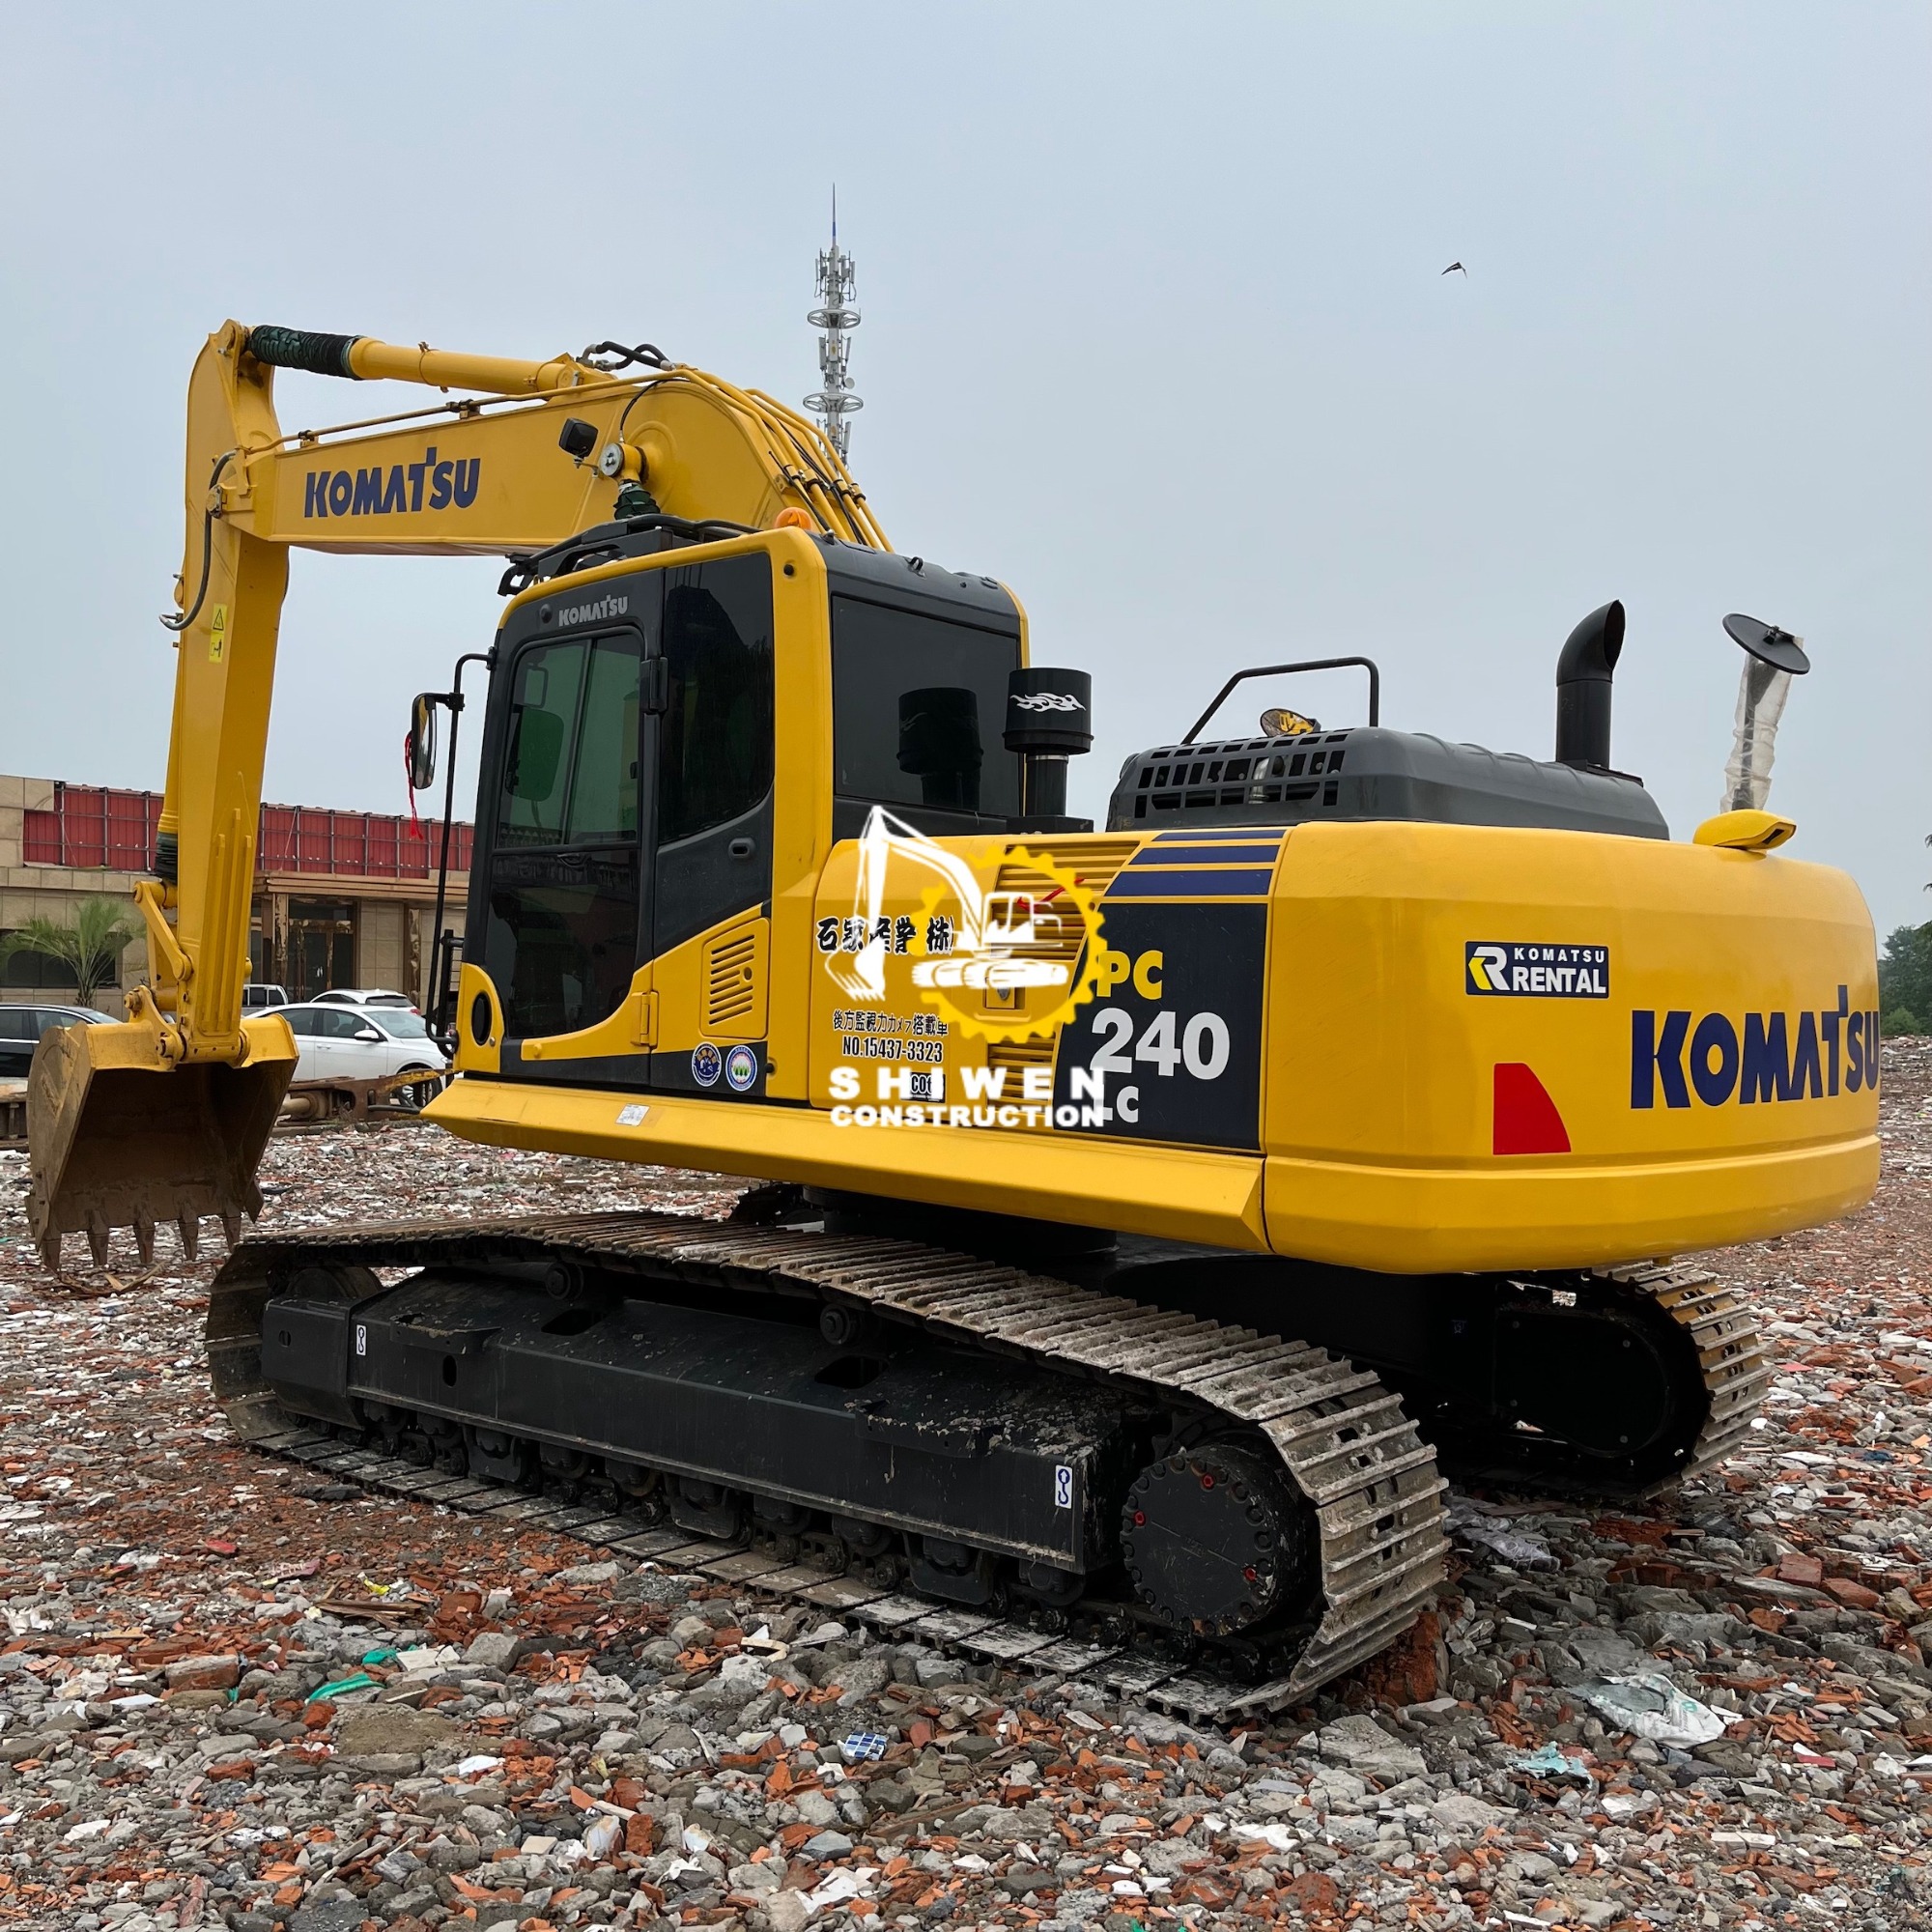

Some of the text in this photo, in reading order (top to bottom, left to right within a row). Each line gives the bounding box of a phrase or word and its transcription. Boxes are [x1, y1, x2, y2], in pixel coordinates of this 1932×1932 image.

[304, 447, 481, 518] KOMATSU
[558, 594, 628, 627] KOMATSU
[1095, 950, 1163, 1001] PC
[1514, 947, 1605, 963] KOMATSU
[1512, 966, 1606, 994] RENTAL
[842, 1036, 943, 1063] NO.15437-3323
[1090, 1008, 1231, 1080] 240
[1631, 984, 1879, 1109] KOMATSU
